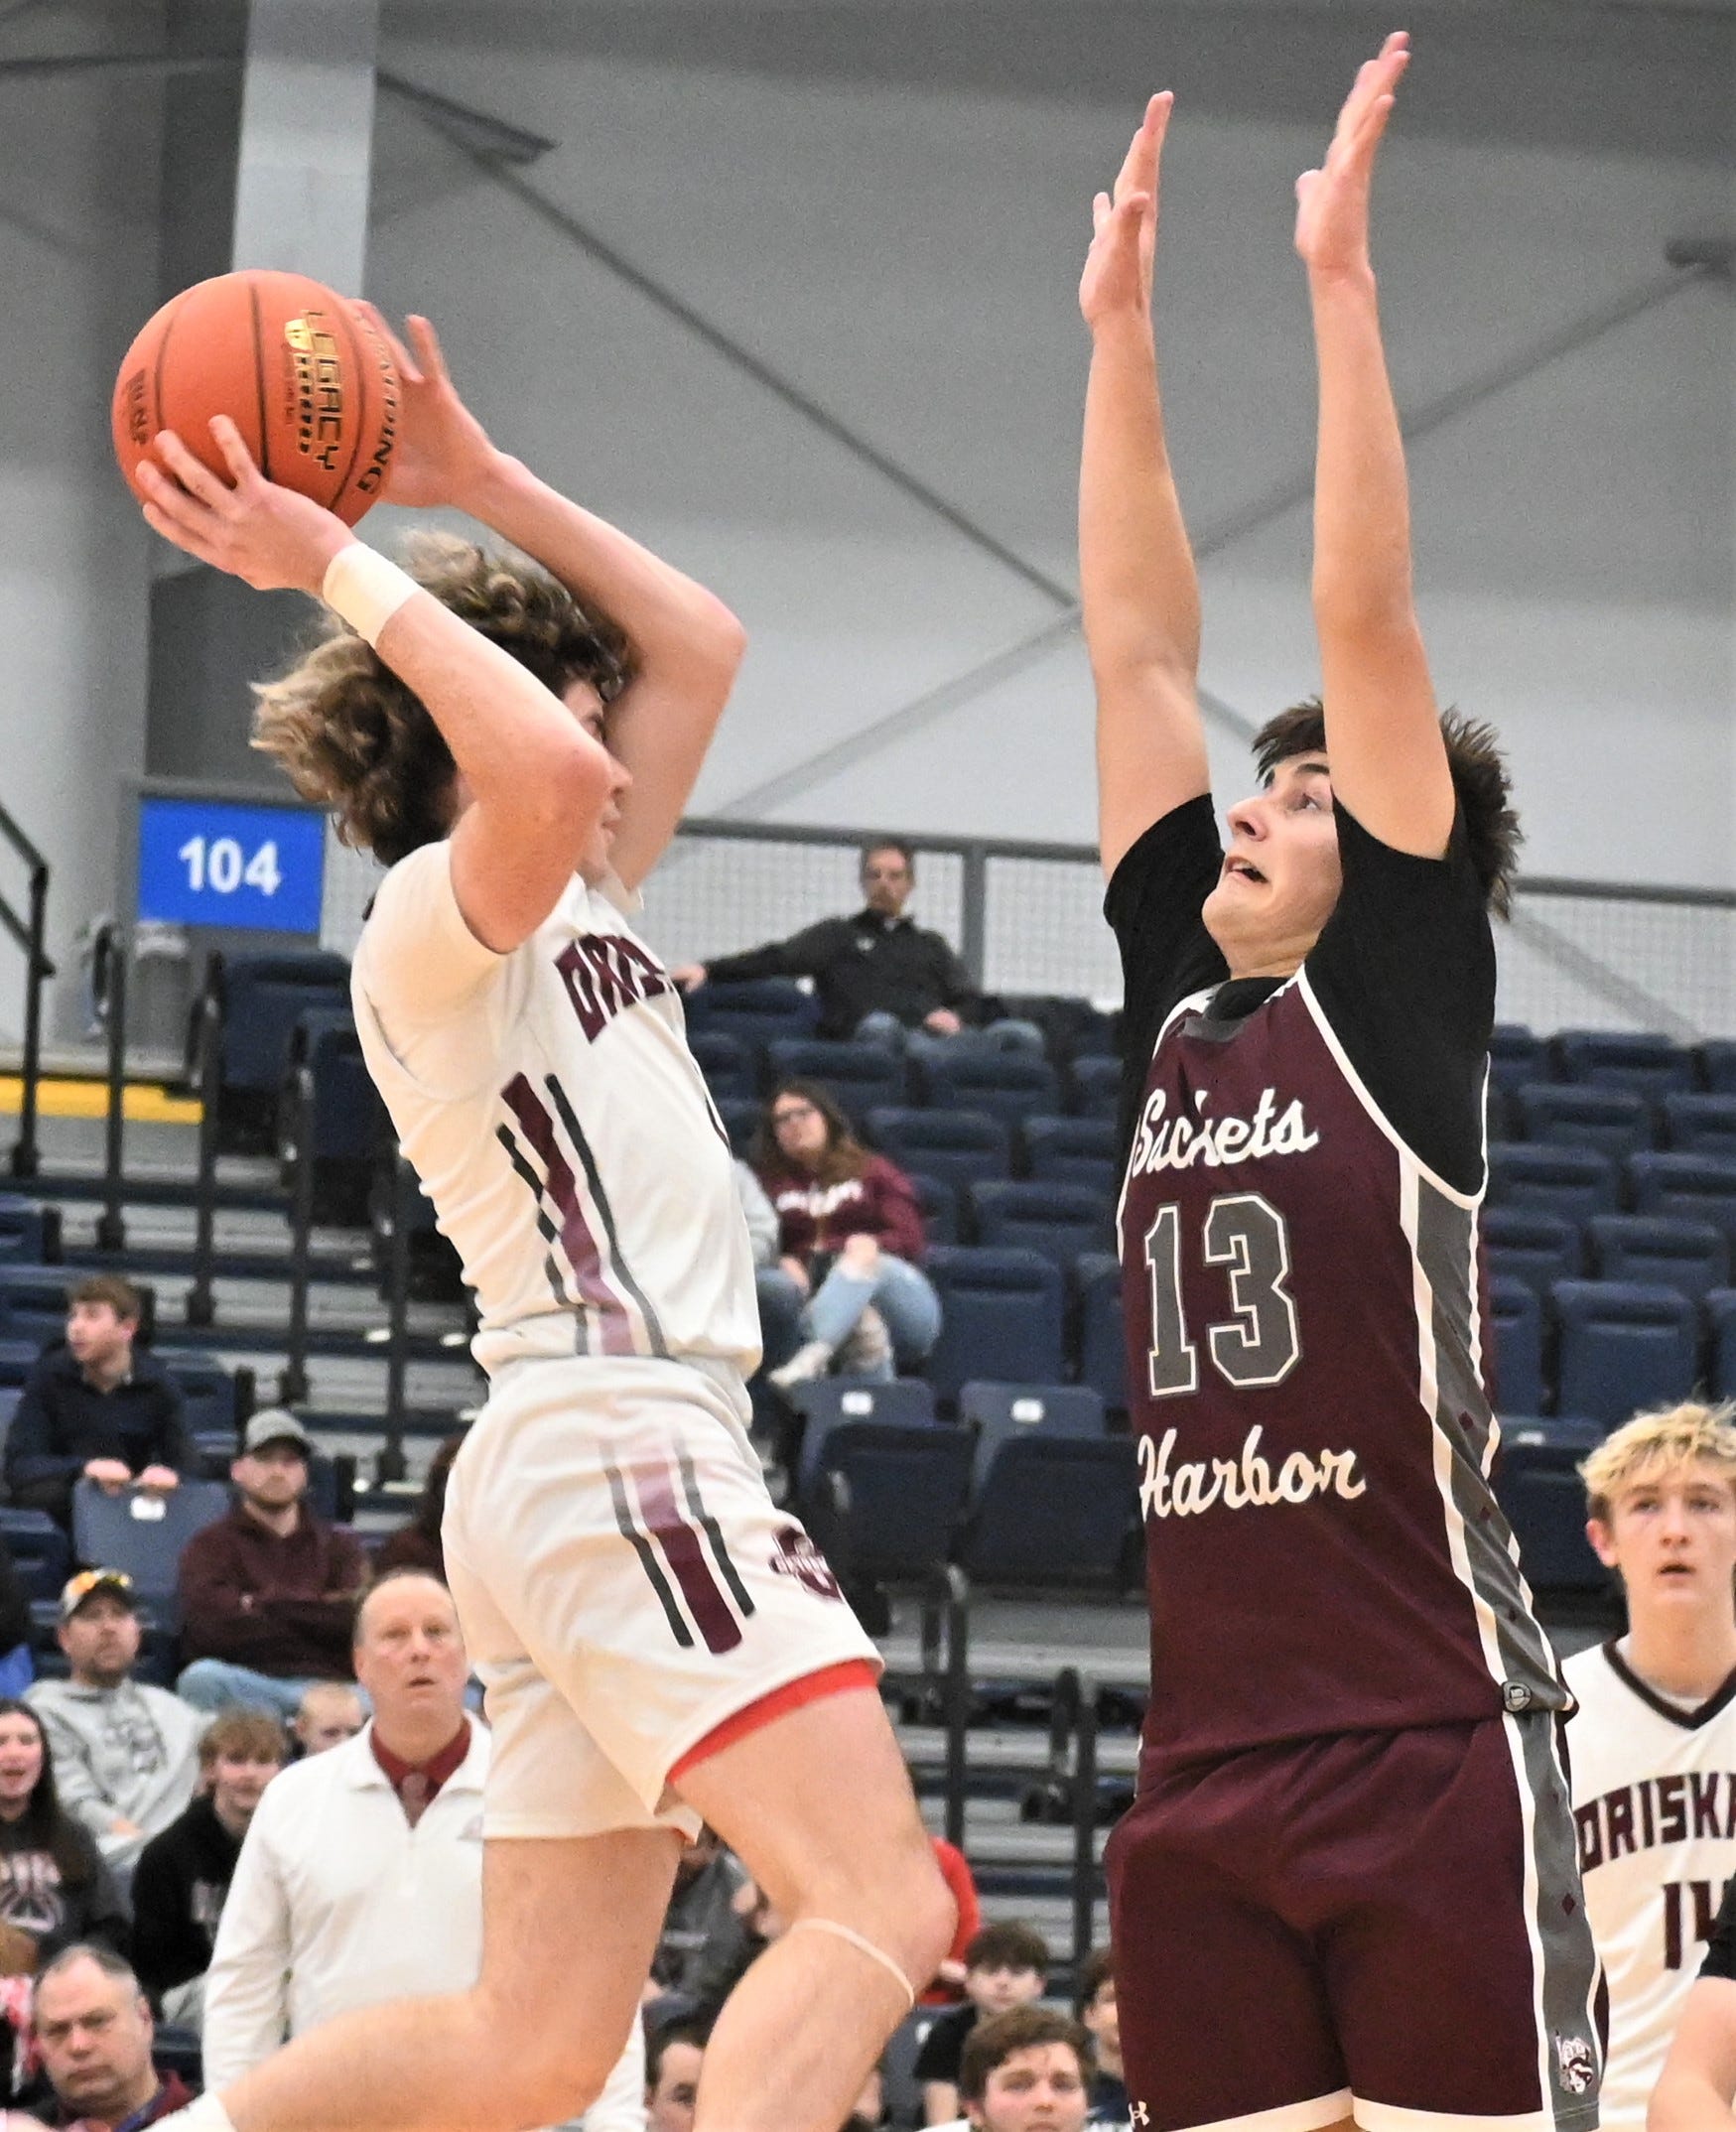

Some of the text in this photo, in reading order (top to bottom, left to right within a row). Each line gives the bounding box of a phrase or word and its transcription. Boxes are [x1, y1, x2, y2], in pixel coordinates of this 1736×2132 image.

[301, 309, 342, 471] LEGACY
[178, 834, 281, 896] 104
[553, 932, 674, 1044] ORIS
[1144, 1192, 1302, 1399] 13
[1136, 1424, 1367, 1524] Harbor
